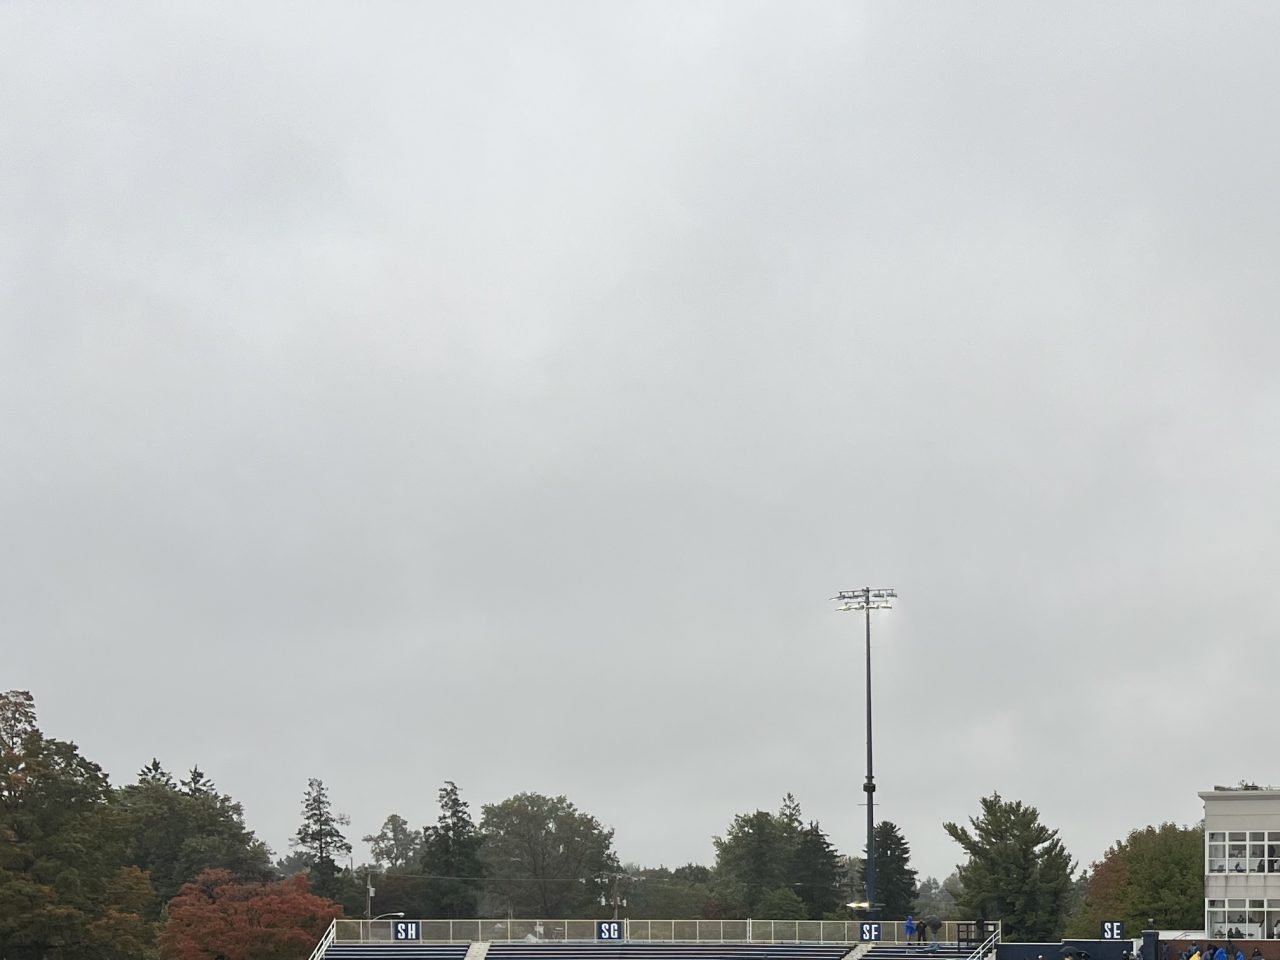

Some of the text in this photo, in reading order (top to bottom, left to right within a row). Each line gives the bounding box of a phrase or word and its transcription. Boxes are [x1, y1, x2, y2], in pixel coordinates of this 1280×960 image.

[398, 923, 416, 939] SH
[602, 923, 618, 939] SG
[863, 924, 878, 940] SF
[1105, 923, 1120, 938] SE
